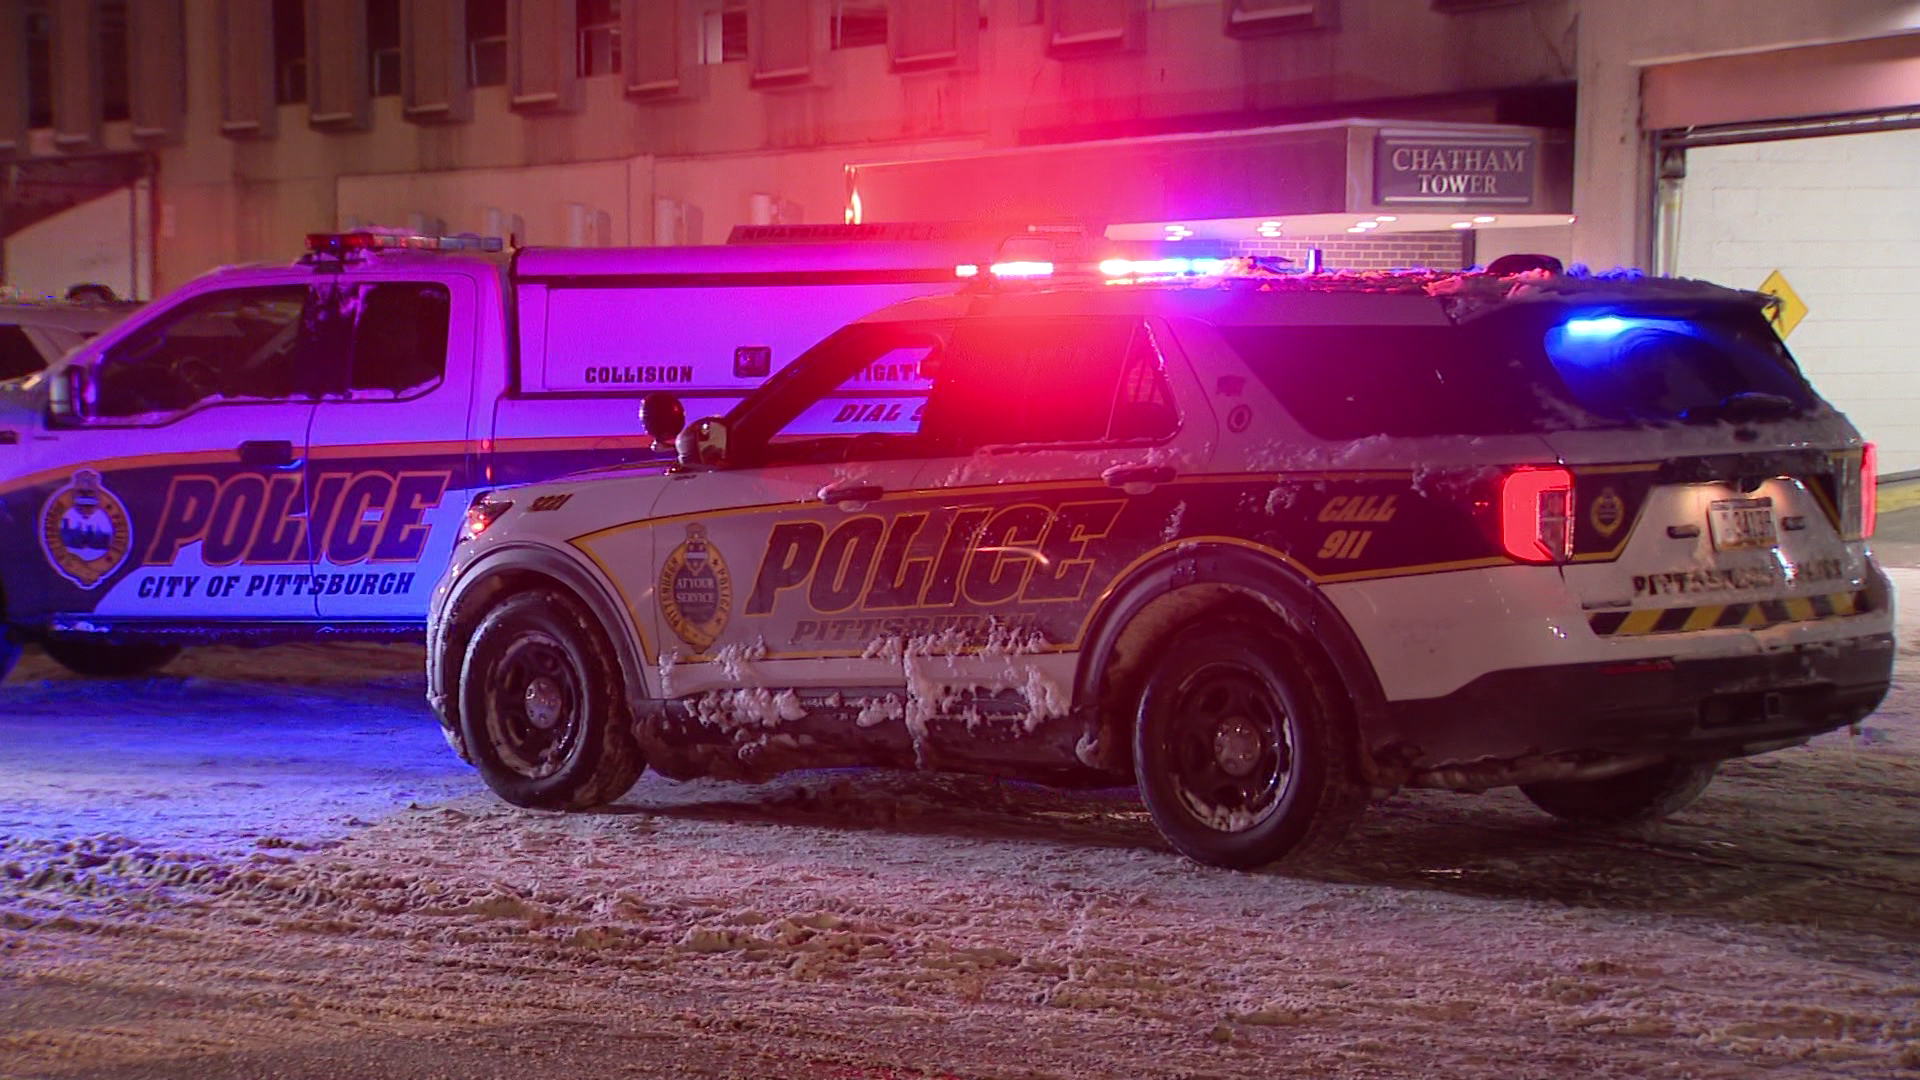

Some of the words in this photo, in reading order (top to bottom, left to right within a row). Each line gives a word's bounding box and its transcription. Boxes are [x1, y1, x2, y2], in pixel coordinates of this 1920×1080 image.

[1392, 148, 1525, 172] CHATHAM
[1418, 174, 1498, 194] TOWER
[585, 366, 694, 384] COLLISION
[833, 403, 902, 423] DIAL
[141, 470, 452, 567] POLICE
[1317, 494, 1398, 522] CALL
[1317, 530, 1373, 559] 911
[742, 499, 1130, 617] POLICE
[138, 576, 200, 598] CITY
[206, 575, 241, 598] OF
[245, 572, 416, 597] PITTSBURGH
[676, 592, 715, 603] SERVICE
